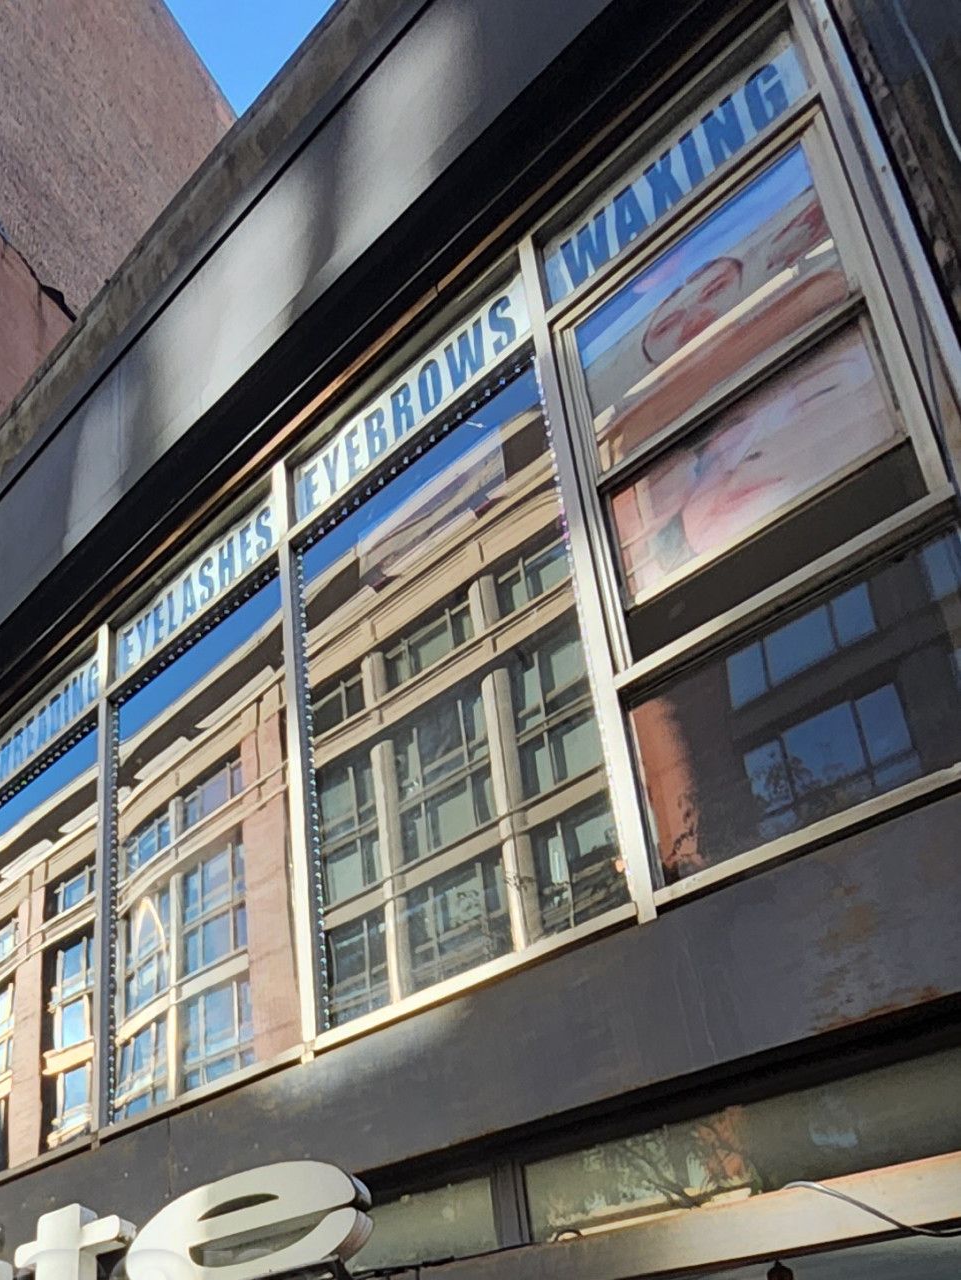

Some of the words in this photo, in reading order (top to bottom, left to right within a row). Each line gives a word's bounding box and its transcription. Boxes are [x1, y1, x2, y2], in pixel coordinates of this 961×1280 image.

[559, 63, 789, 291] WAXING
[304, 294, 518, 508] EYEBROWS
[119, 505, 274, 670] EYELASHES
